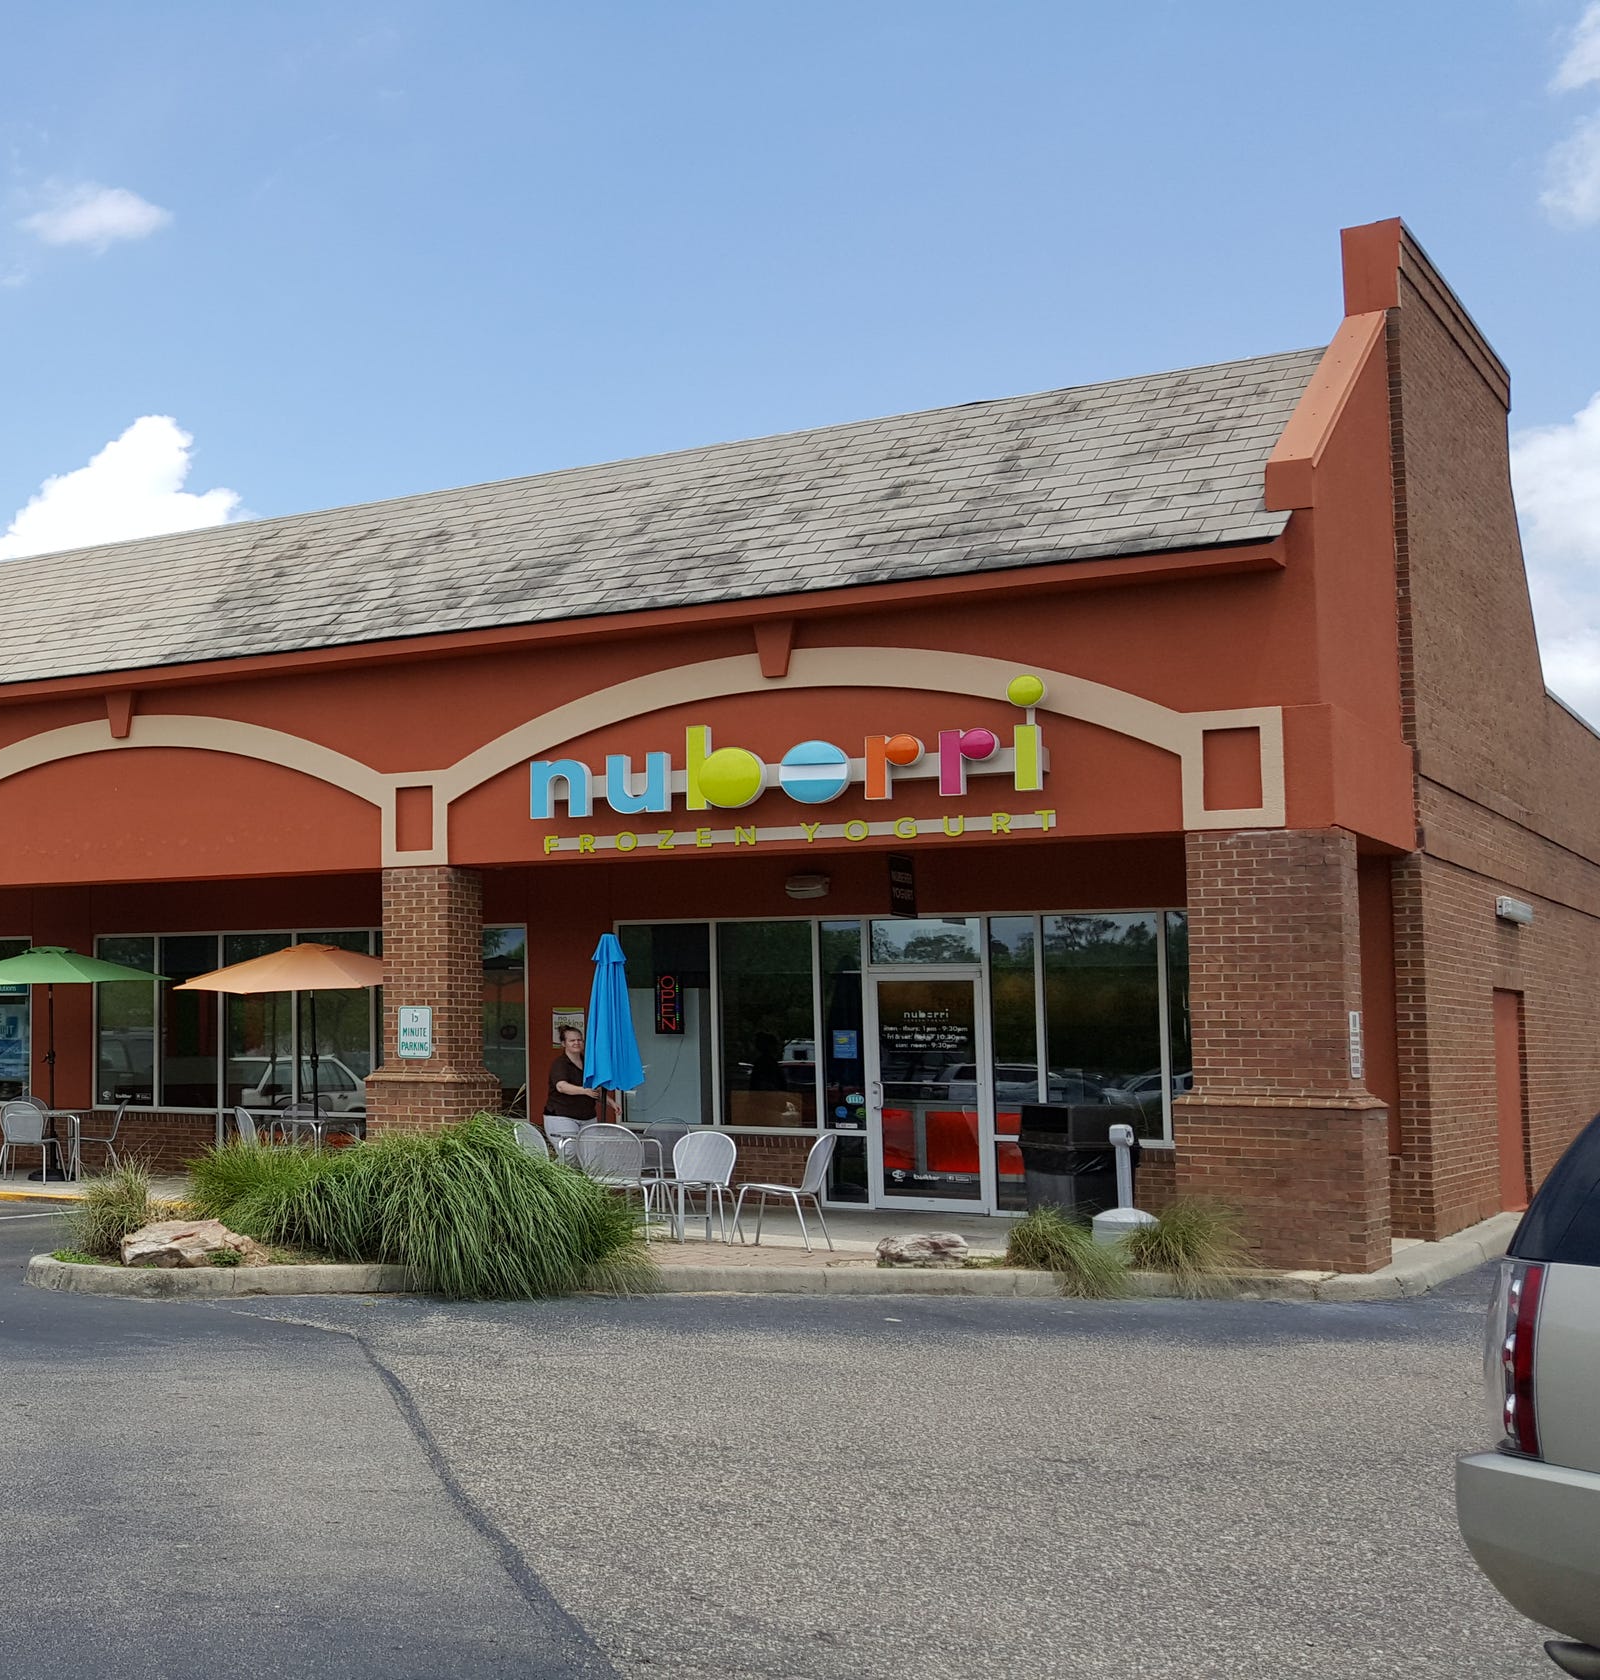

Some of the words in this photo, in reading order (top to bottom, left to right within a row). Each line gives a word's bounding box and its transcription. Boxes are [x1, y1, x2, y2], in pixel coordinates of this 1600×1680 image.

[543, 824, 757, 855] FROZEN
[799, 809, 1057, 845] YOGURT
[660, 975, 676, 1031] OPEN
[402, 1027, 428, 1037] MINUTE
[401, 1041, 429, 1052] PARKING
